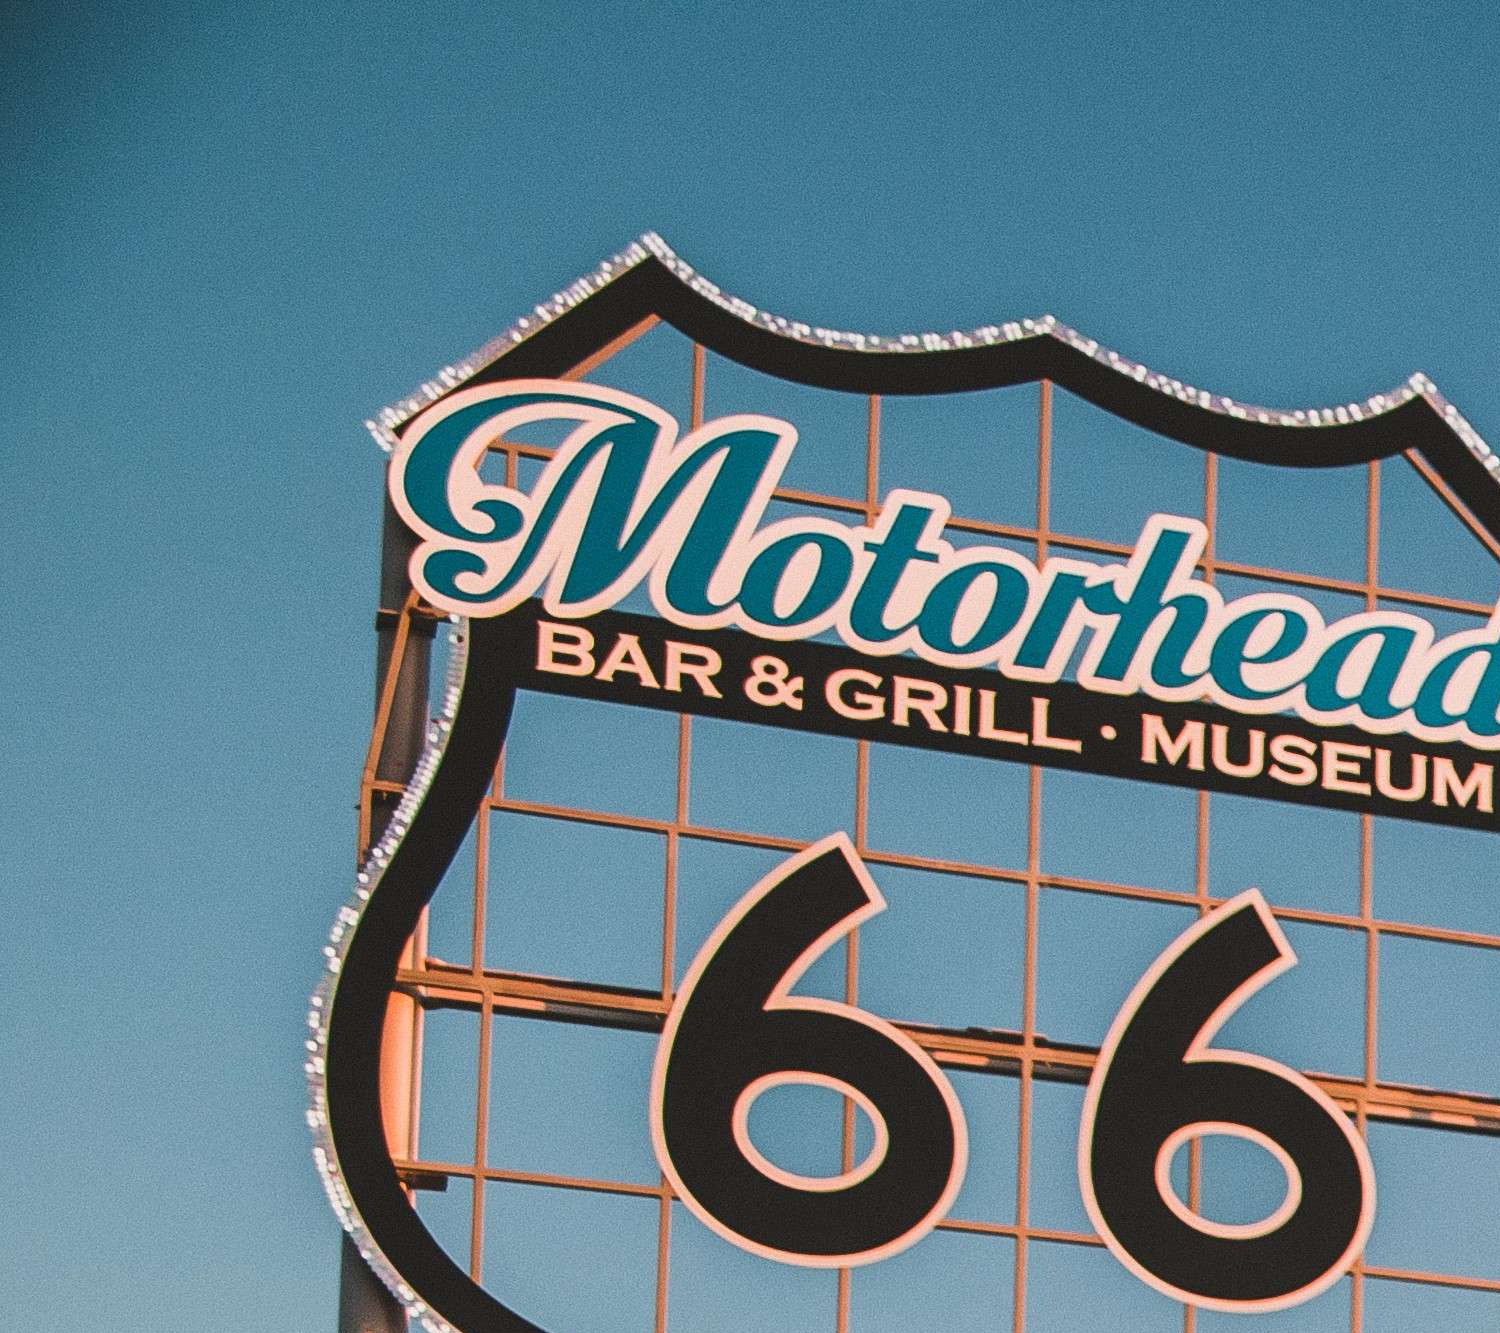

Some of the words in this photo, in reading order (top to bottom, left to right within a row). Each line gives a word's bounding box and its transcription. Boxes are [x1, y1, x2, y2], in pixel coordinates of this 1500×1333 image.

[535, 619, 724, 699] BAR
[742, 654, 804, 711] &
[824, 667, 1083, 755] GRILL
[1141, 712, 1495, 814] MUSEUM
